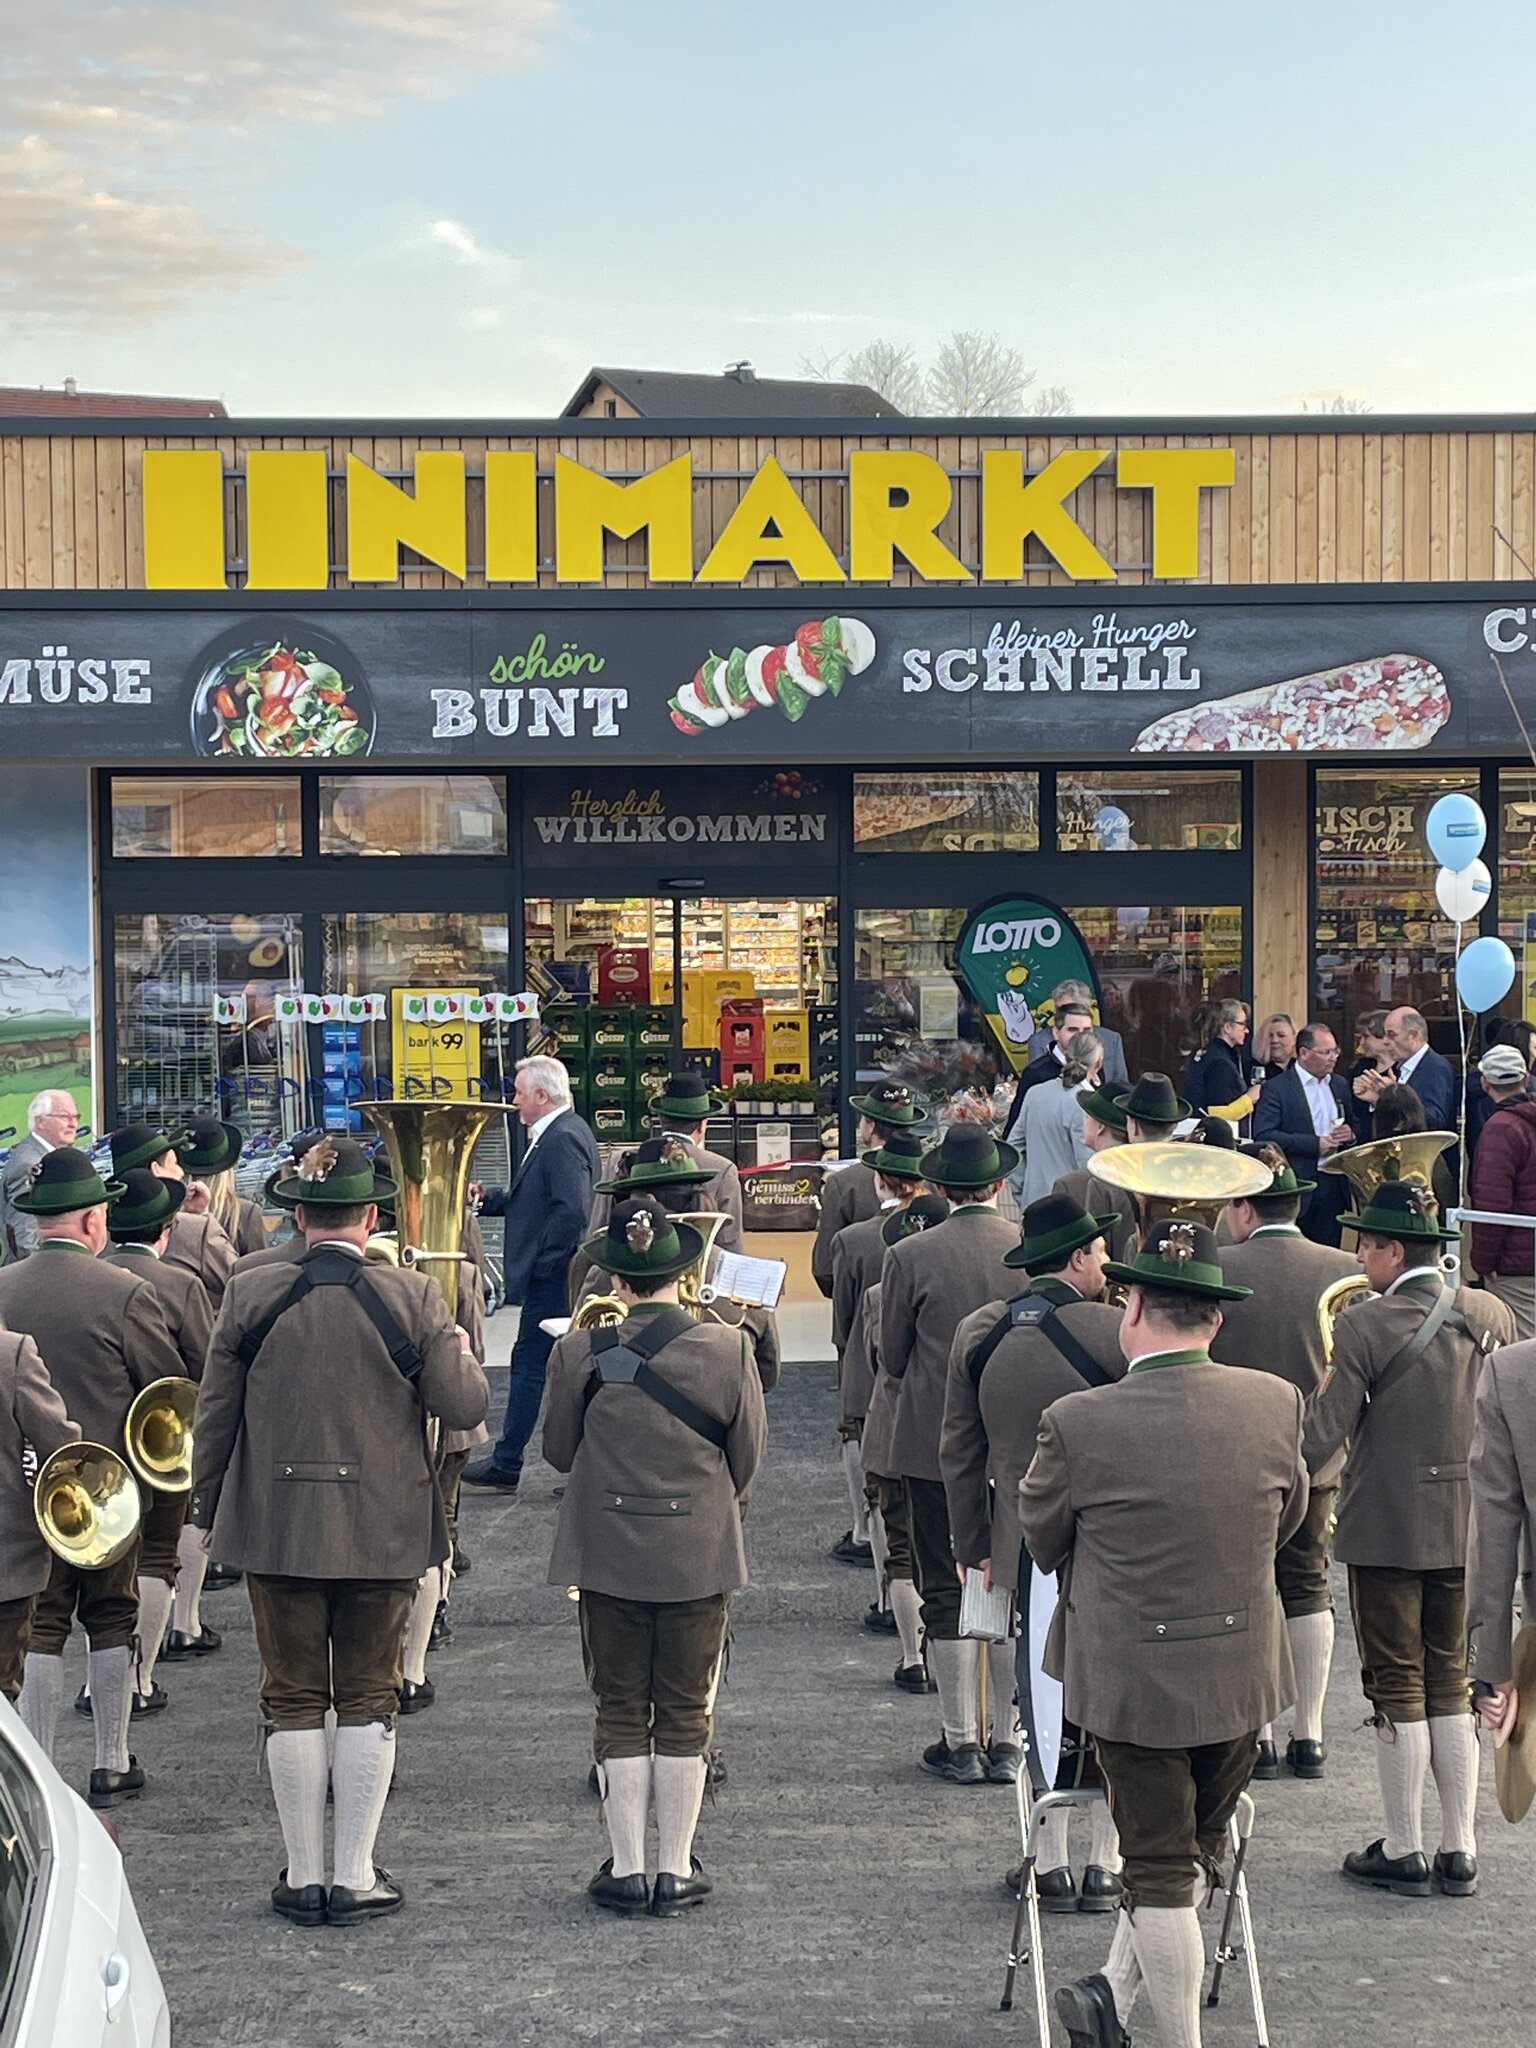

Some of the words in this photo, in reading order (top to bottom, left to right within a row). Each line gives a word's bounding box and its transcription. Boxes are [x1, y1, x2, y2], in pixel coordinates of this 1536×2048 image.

[142, 448, 1236, 589] UNIMARKT
[987, 620, 1084, 651] kleiner
[1092, 613, 1197, 651] Hunger
[489, 633, 606, 684] schön
[903, 646, 1201, 692] SCHNELL
[430, 688, 629, 738] BUNT
[571, 789, 665, 823] Herzlich
[1065, 811, 1135, 834] Hunger
[1317, 806, 1415, 834] ISCH
[533, 814, 827, 843] WILLKOMMEN
[972, 917, 1061, 954] LOTTO
[408, 1036, 440, 1048] bank
[441, 1033, 463, 1050] 99
[744, 1178, 795, 1196] Genuss
